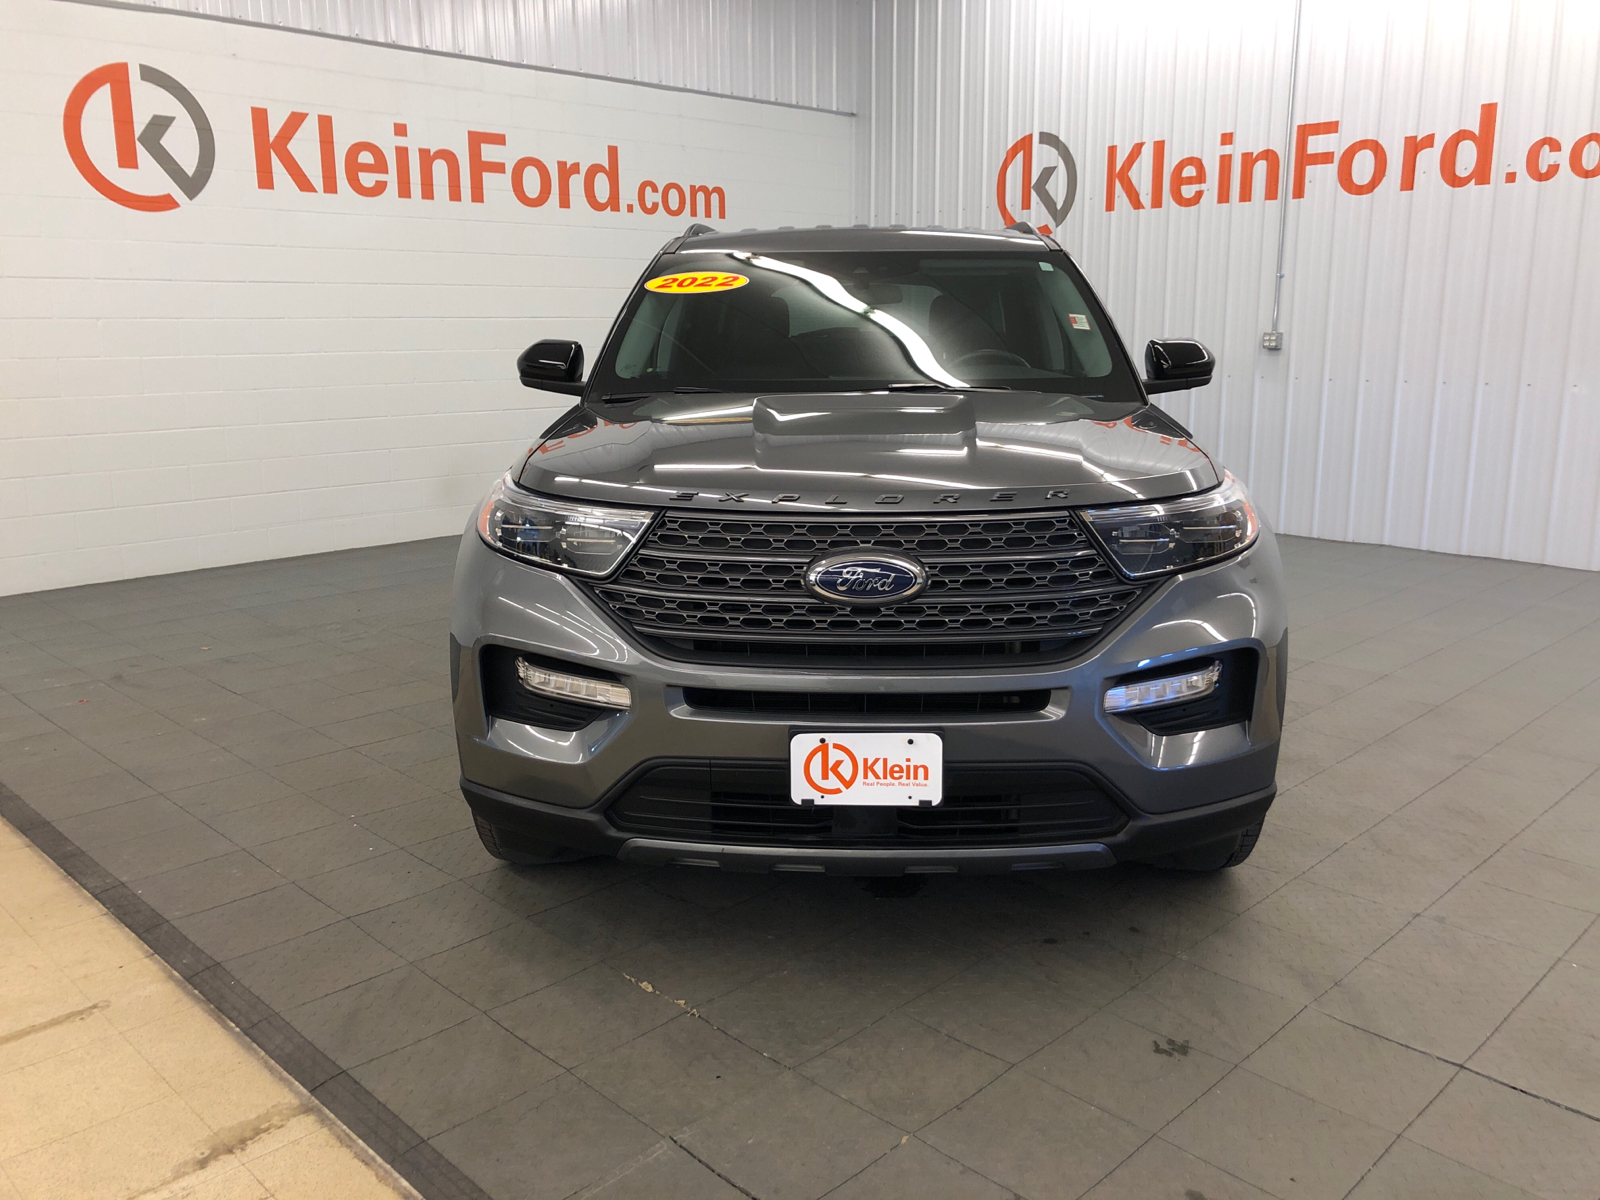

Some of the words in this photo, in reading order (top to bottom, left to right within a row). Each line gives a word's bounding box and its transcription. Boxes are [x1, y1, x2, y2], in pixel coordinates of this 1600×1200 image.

[250, 106, 727, 220] KleinFord.com
[654, 275, 740, 289] 2022
[668, 488, 1070, 505] EXPLORER
[830, 566, 898, 591] Ford
[862, 757, 930, 780] Klein
